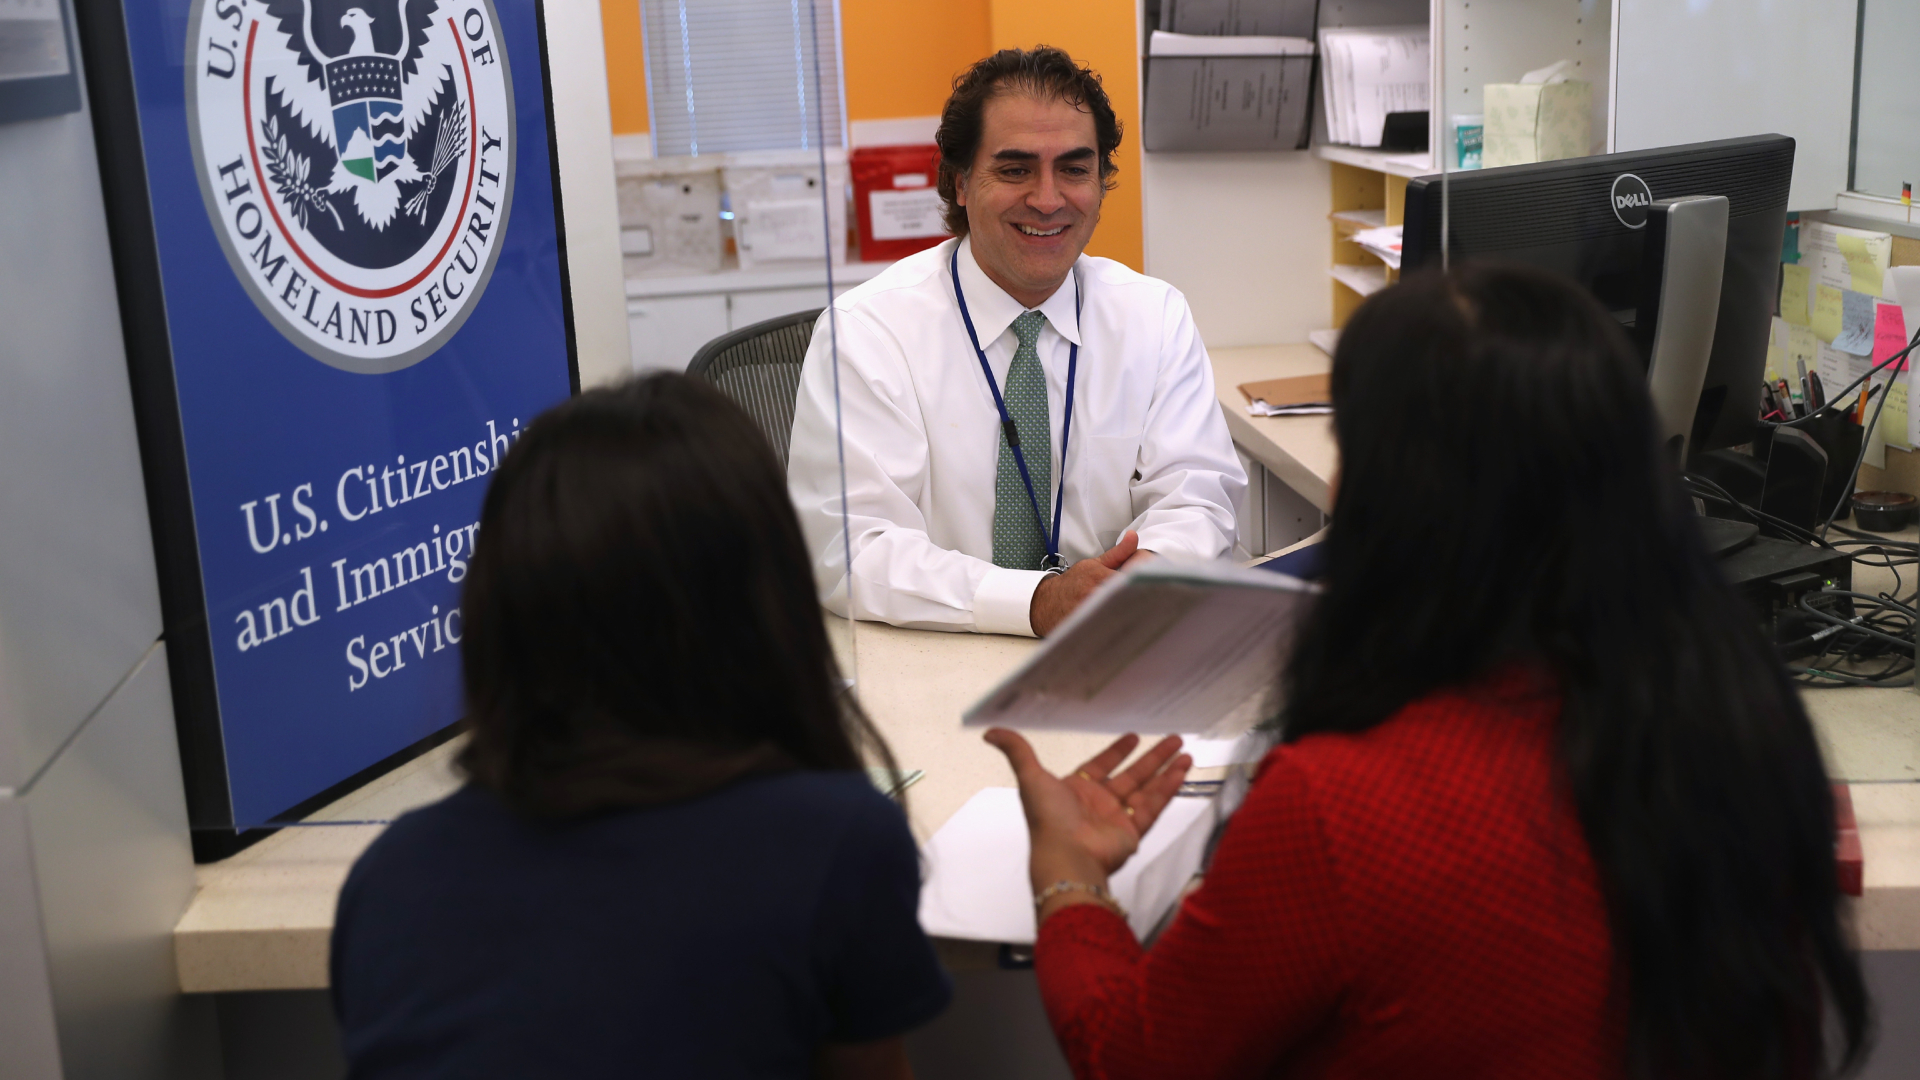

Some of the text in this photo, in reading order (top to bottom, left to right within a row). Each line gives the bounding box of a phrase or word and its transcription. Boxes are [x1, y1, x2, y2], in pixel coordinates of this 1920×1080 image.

[206, 0, 494, 80] U.S. OF
[217, 125, 502, 346] HOMELAND SECURITY
[1615, 192, 1649, 209] DELL
[240, 417, 530, 554] U.S. Citizenshi
[235, 521, 481, 652] and Immigr
[346, 604, 463, 692] Servic
